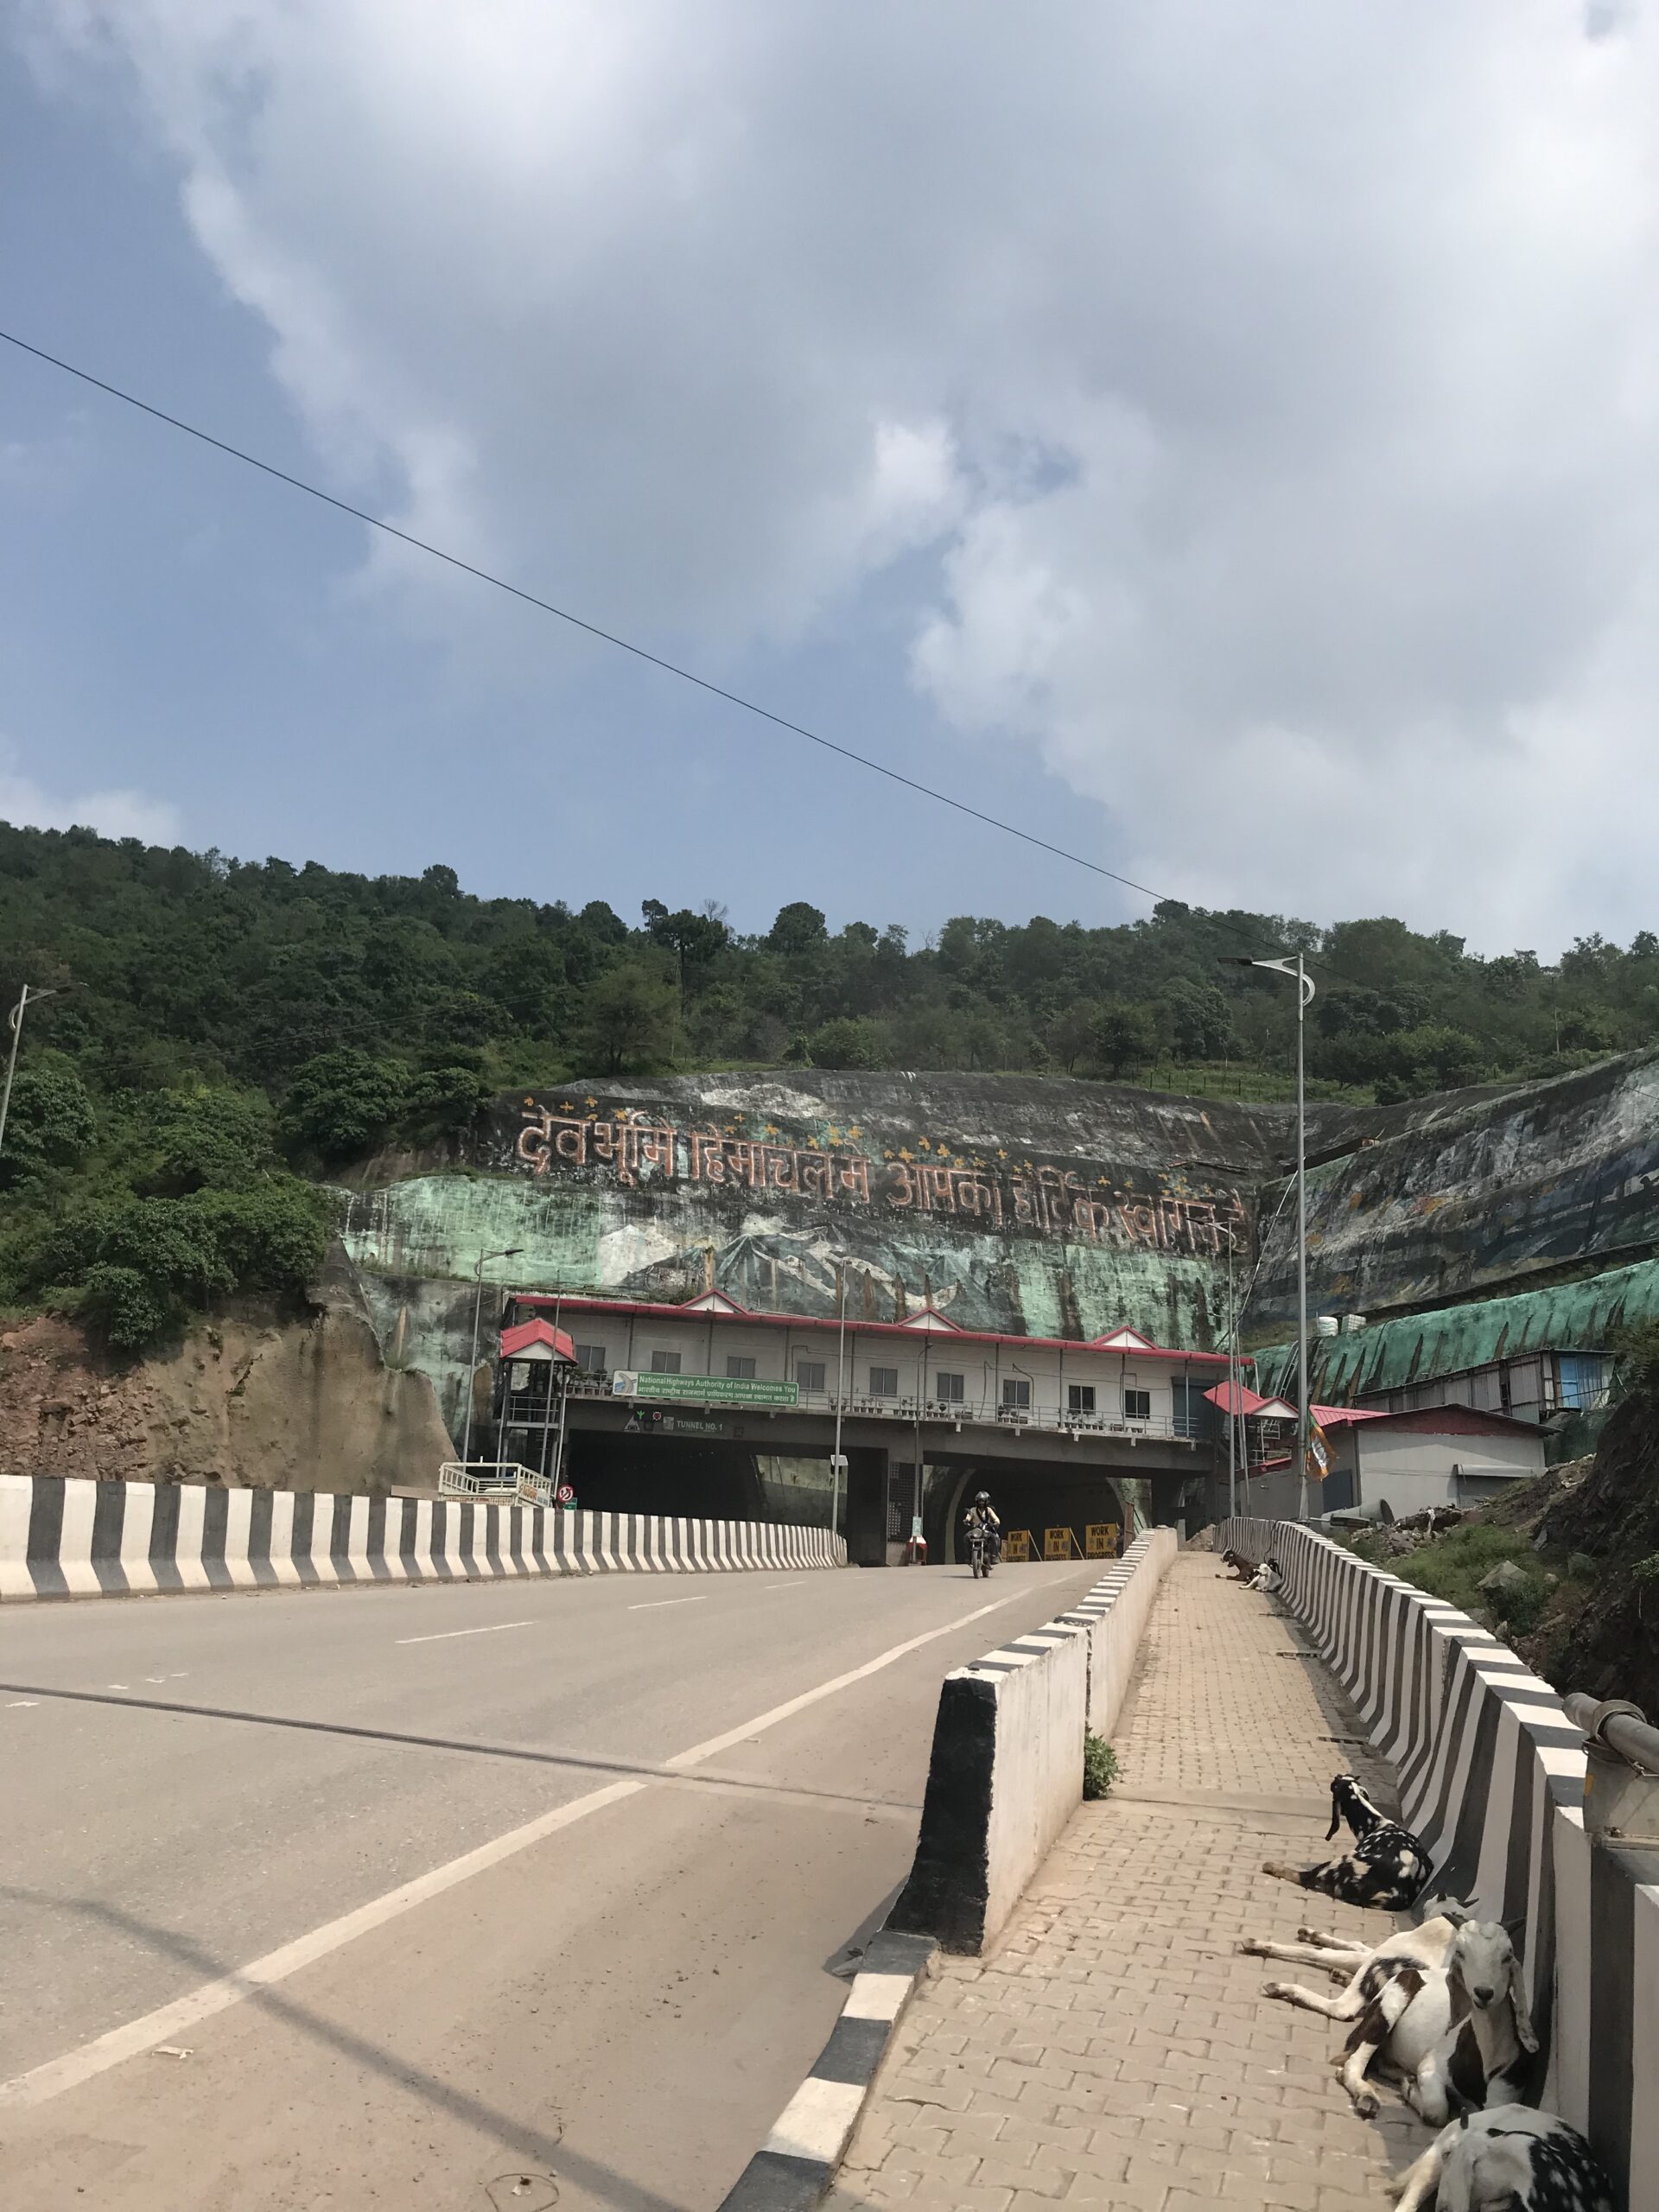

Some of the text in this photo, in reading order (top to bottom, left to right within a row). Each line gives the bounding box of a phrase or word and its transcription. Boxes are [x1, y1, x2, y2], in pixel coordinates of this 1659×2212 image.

[688, 1122, 835, 1199] हिमाचल
[887, 1161, 1003, 1227] आपका
[638, 1385, 660, 1394] भारतीय
[666, 1377, 694, 1388] Highways
[696, 1379, 725, 1389] Authority
[751, 1383, 783, 1392] Welcomes
[784, 1385, 796, 1394] You
[677, 1420, 704, 1430] TUNNEL
[705, 1422, 717, 1431] NO.
[1049, 1529, 1065, 1540] WORK
[1090, 1526, 1109, 1536] WORK
[1052, 1541, 1060, 1553] IN
[1096, 1537, 1104, 1550] IN
